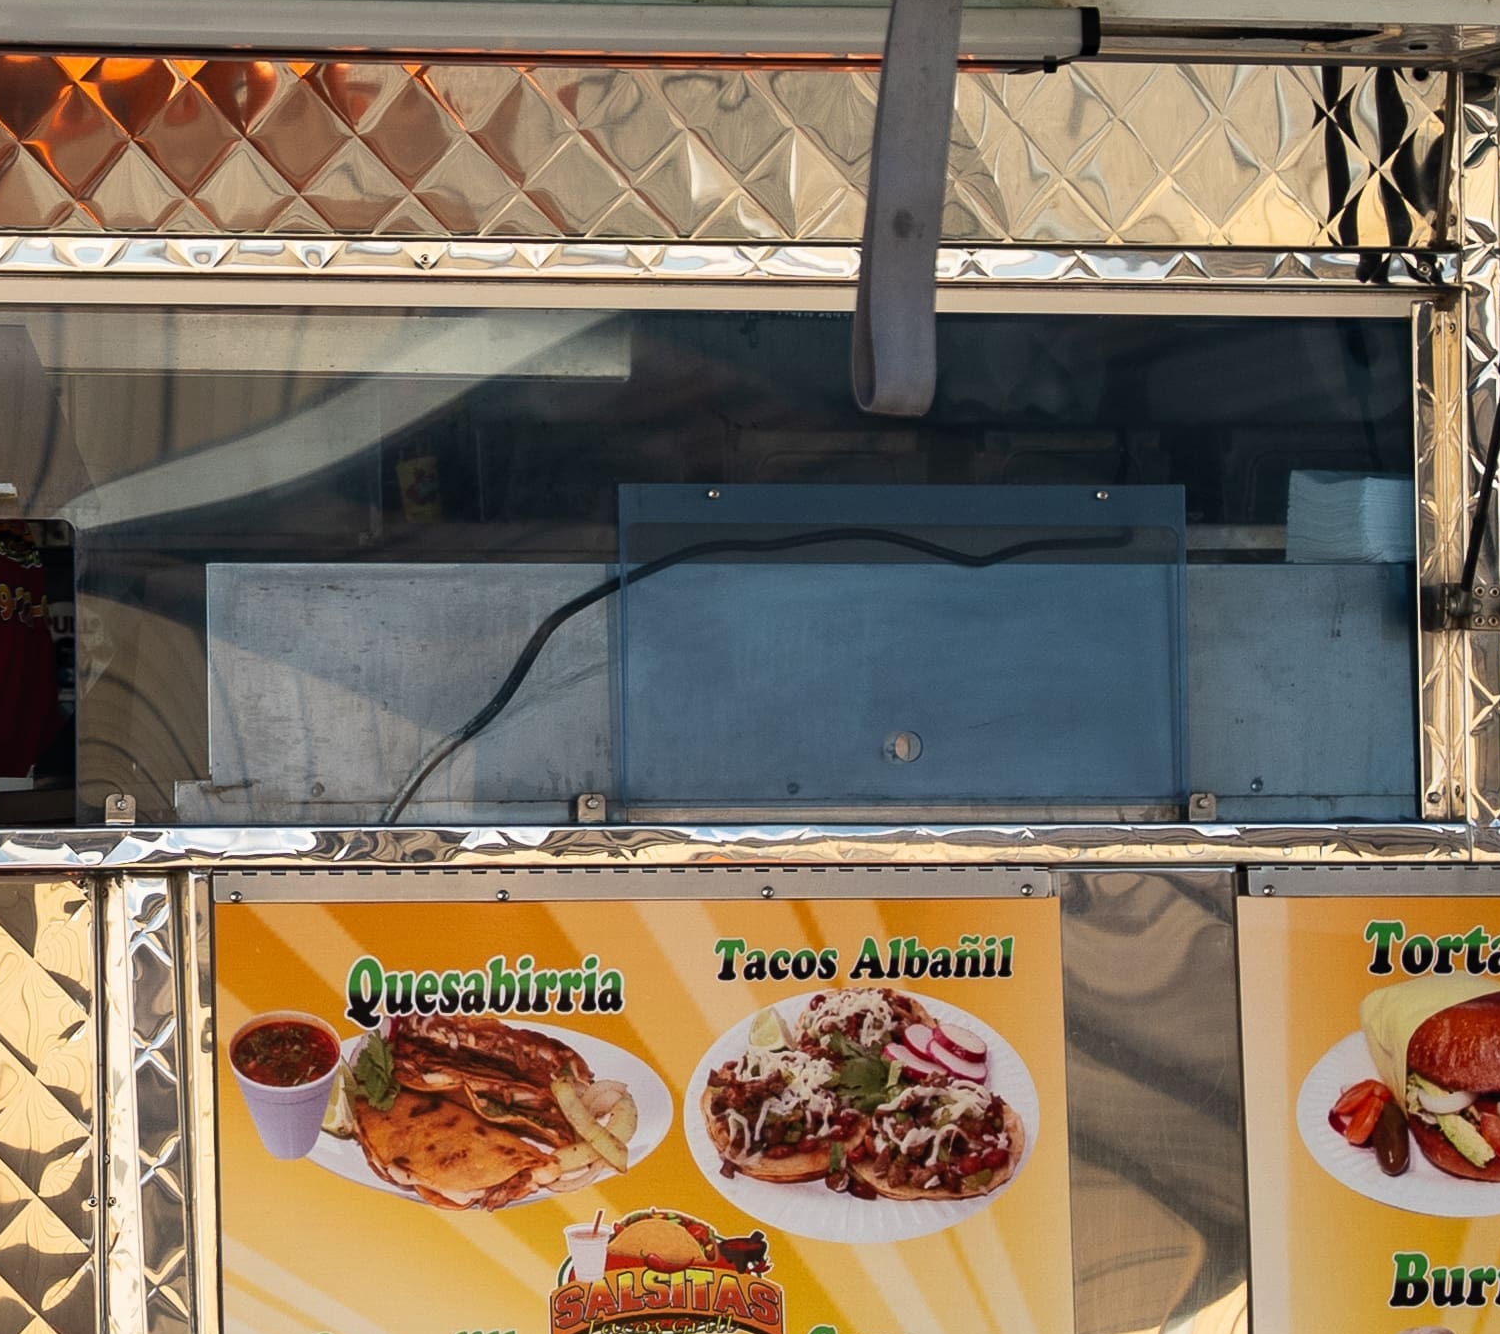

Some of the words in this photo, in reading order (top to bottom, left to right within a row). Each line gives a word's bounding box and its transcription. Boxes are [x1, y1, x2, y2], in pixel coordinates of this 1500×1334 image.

[714, 937, 838, 982] Tacos
[851, 934, 1016, 979] Albañil
[345, 954, 626, 1028] Quesabirria
[554, 1269, 779, 1329] SALSITAS
